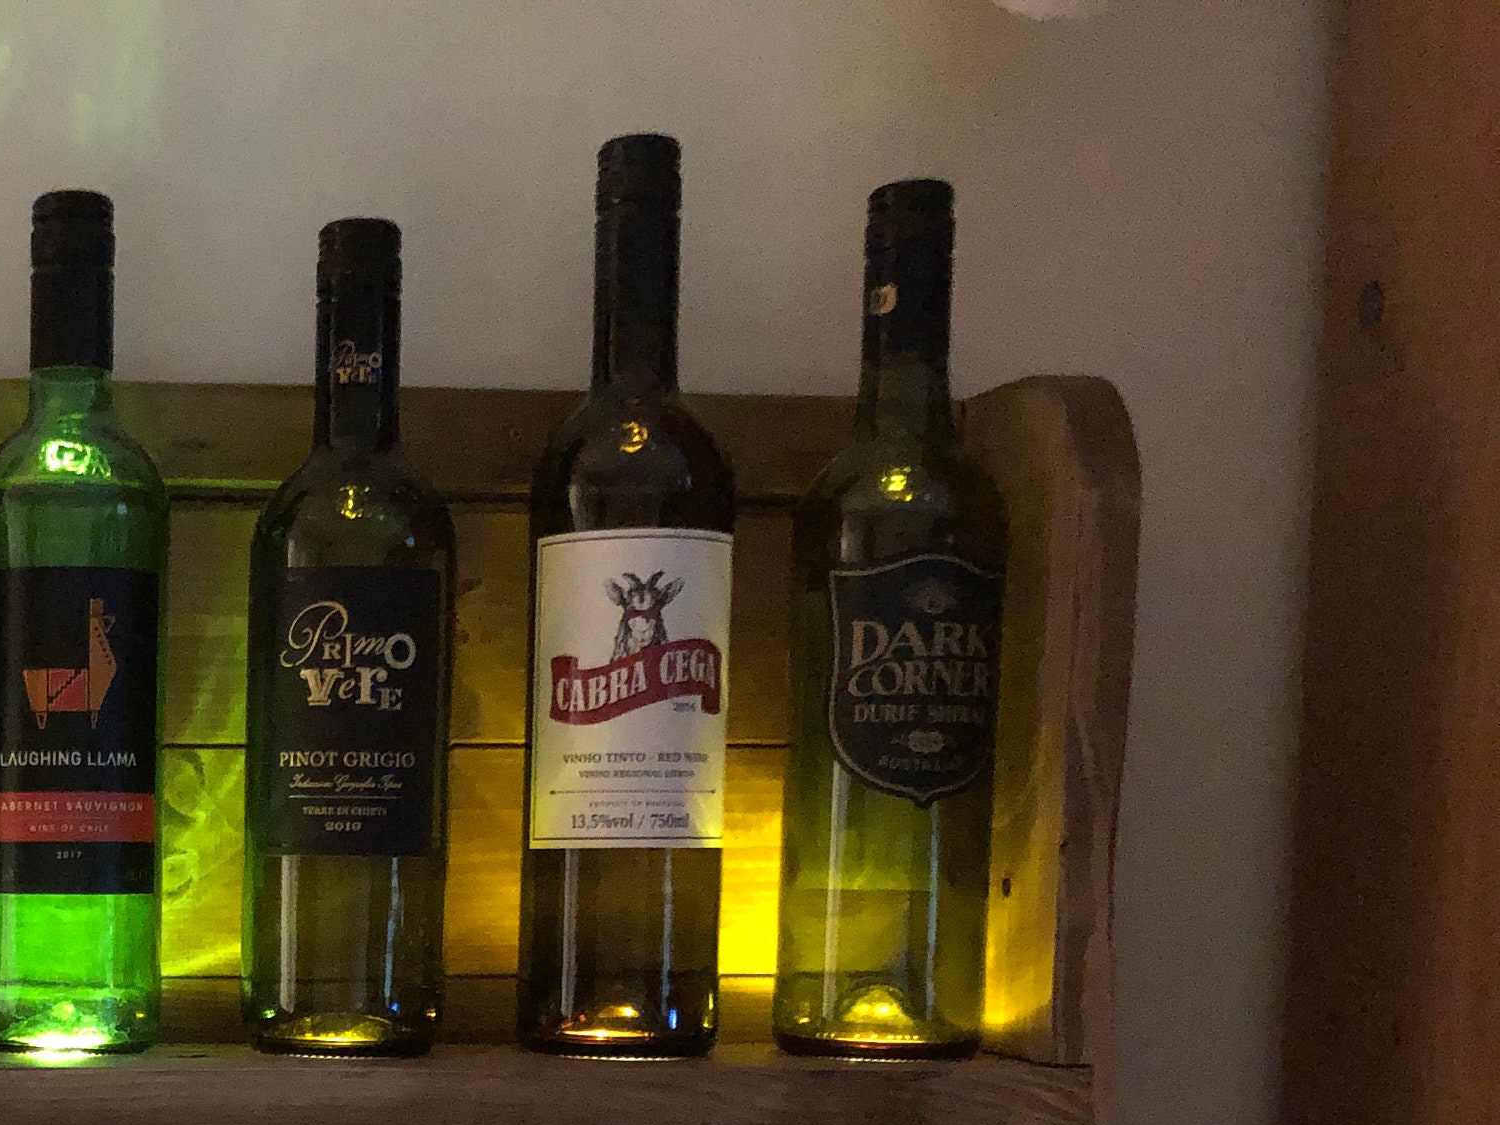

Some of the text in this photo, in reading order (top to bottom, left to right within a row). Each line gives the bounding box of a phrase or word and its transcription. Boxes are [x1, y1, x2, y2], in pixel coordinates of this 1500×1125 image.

[850, 618, 992, 669] DARK
[556, 649, 717, 712] CABRA CEGA
[0, 752, 137, 767] LAUGHING LLAMA
[279, 750, 416, 768] PINOT GRIGIO
[563, 753, 602, 763] VINHO
[606, 753, 646, 762] TINTO
[657, 752, 681, 762] RED
[66, 801, 143, 812] SAUVIGNON
[571, 812, 635, 830] 13,5%vol
[650, 813, 690, 829] 750ml
[56, 851, 82, 859] 2017
